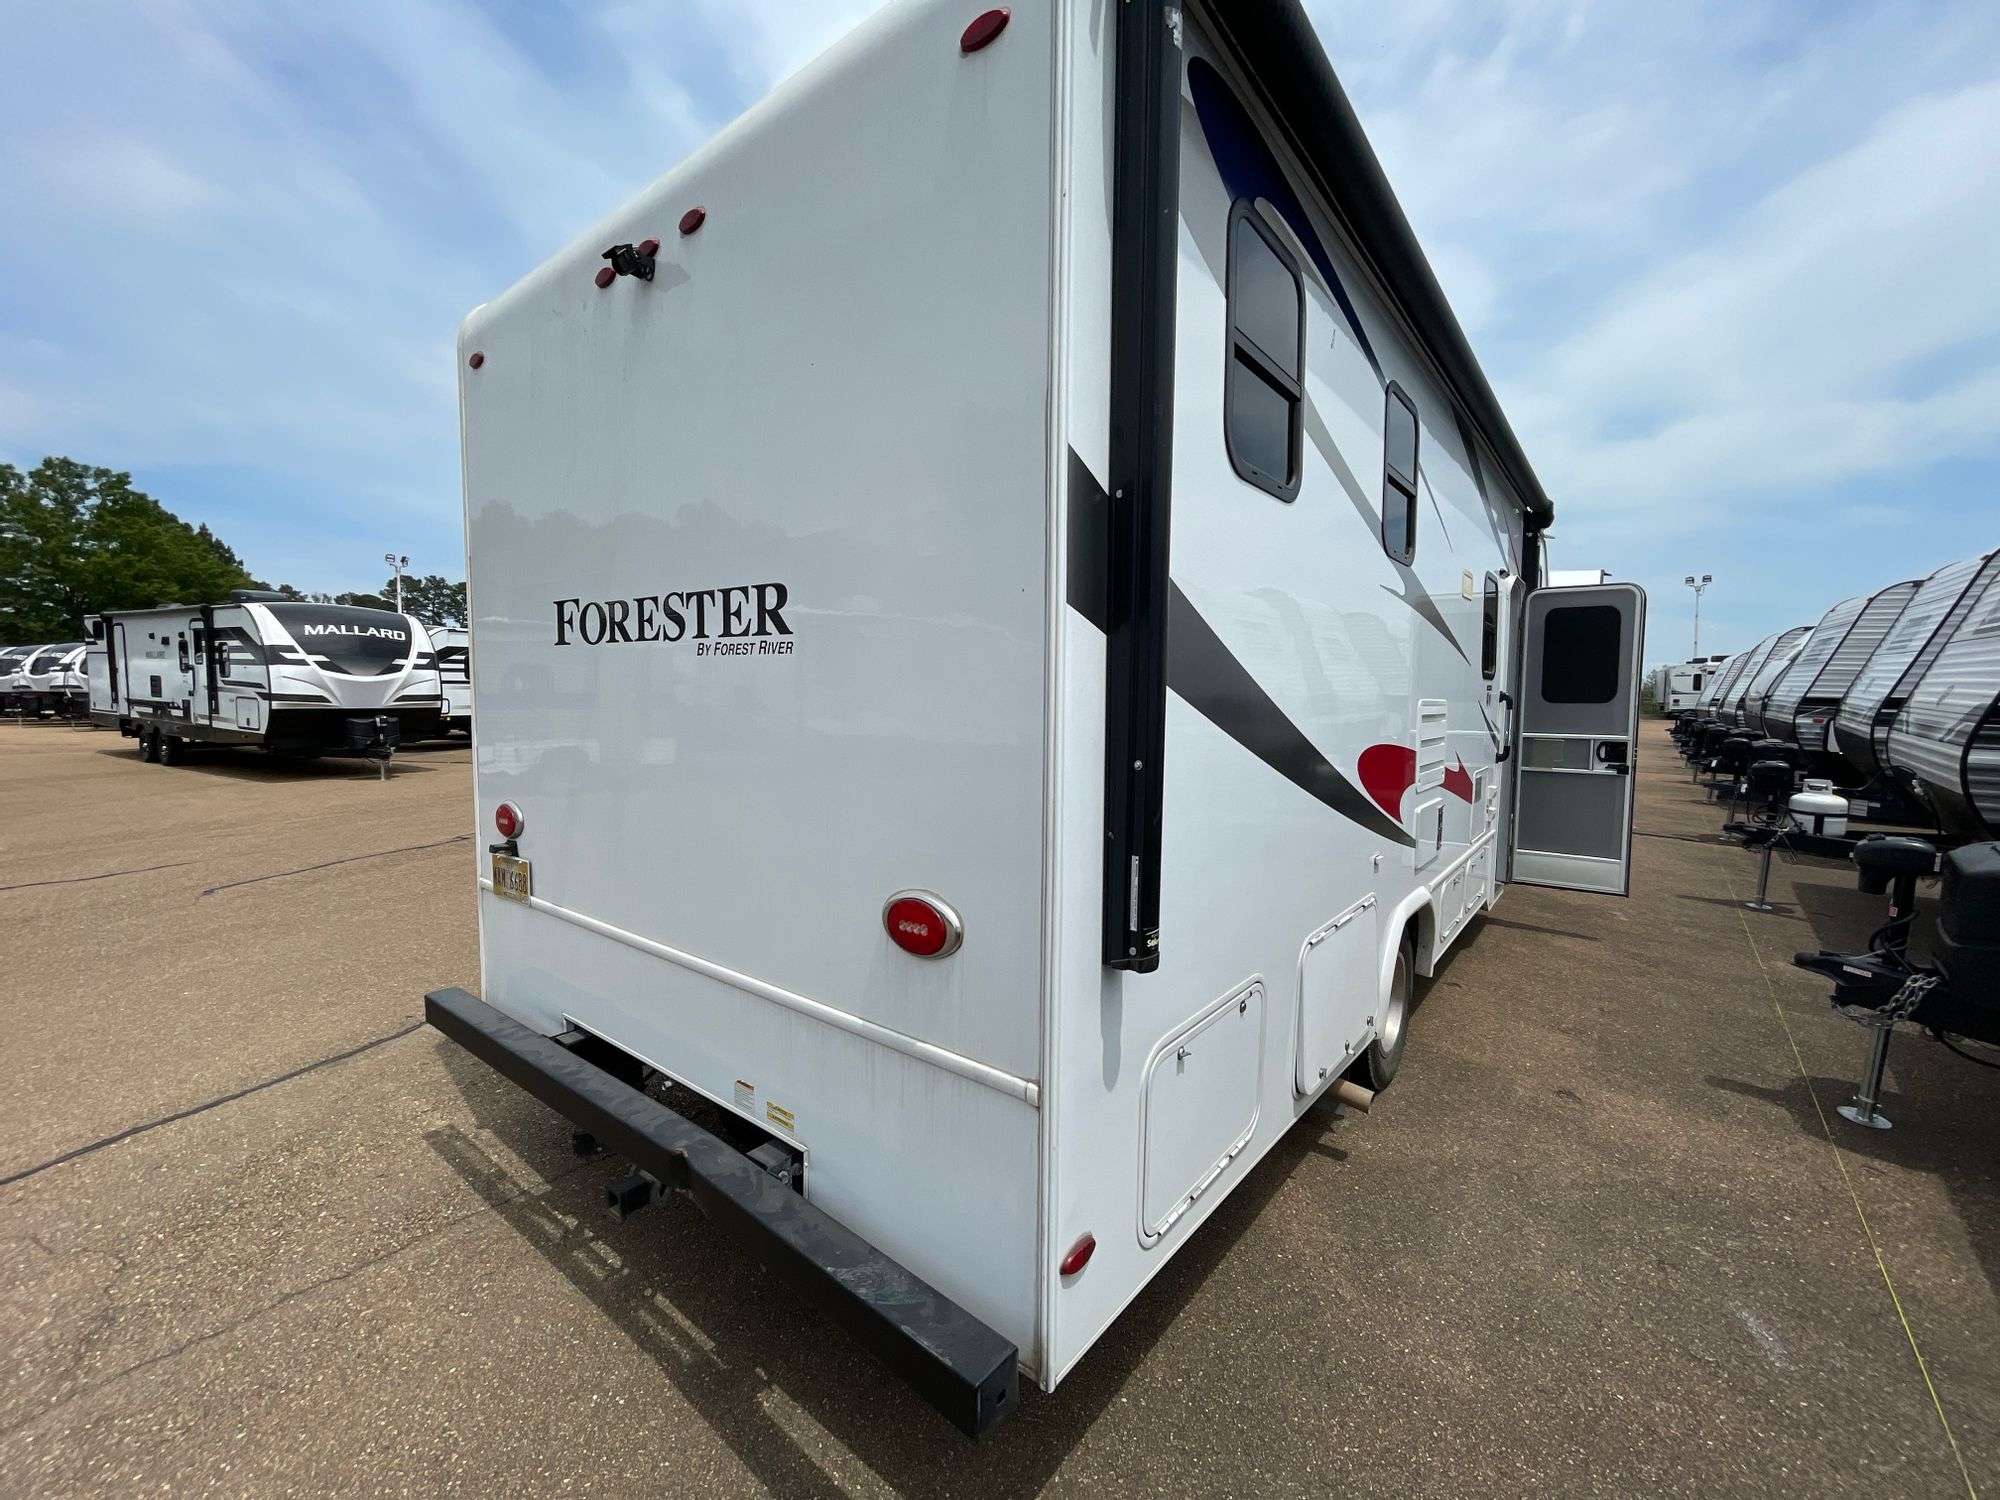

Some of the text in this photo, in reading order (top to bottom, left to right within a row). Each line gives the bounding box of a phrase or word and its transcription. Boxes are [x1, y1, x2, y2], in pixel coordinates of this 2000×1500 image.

[553, 582, 793, 645] FORESTER
[304, 624, 406, 641] MALLARD
[696, 640, 793, 656] BY FOREST RIVER
